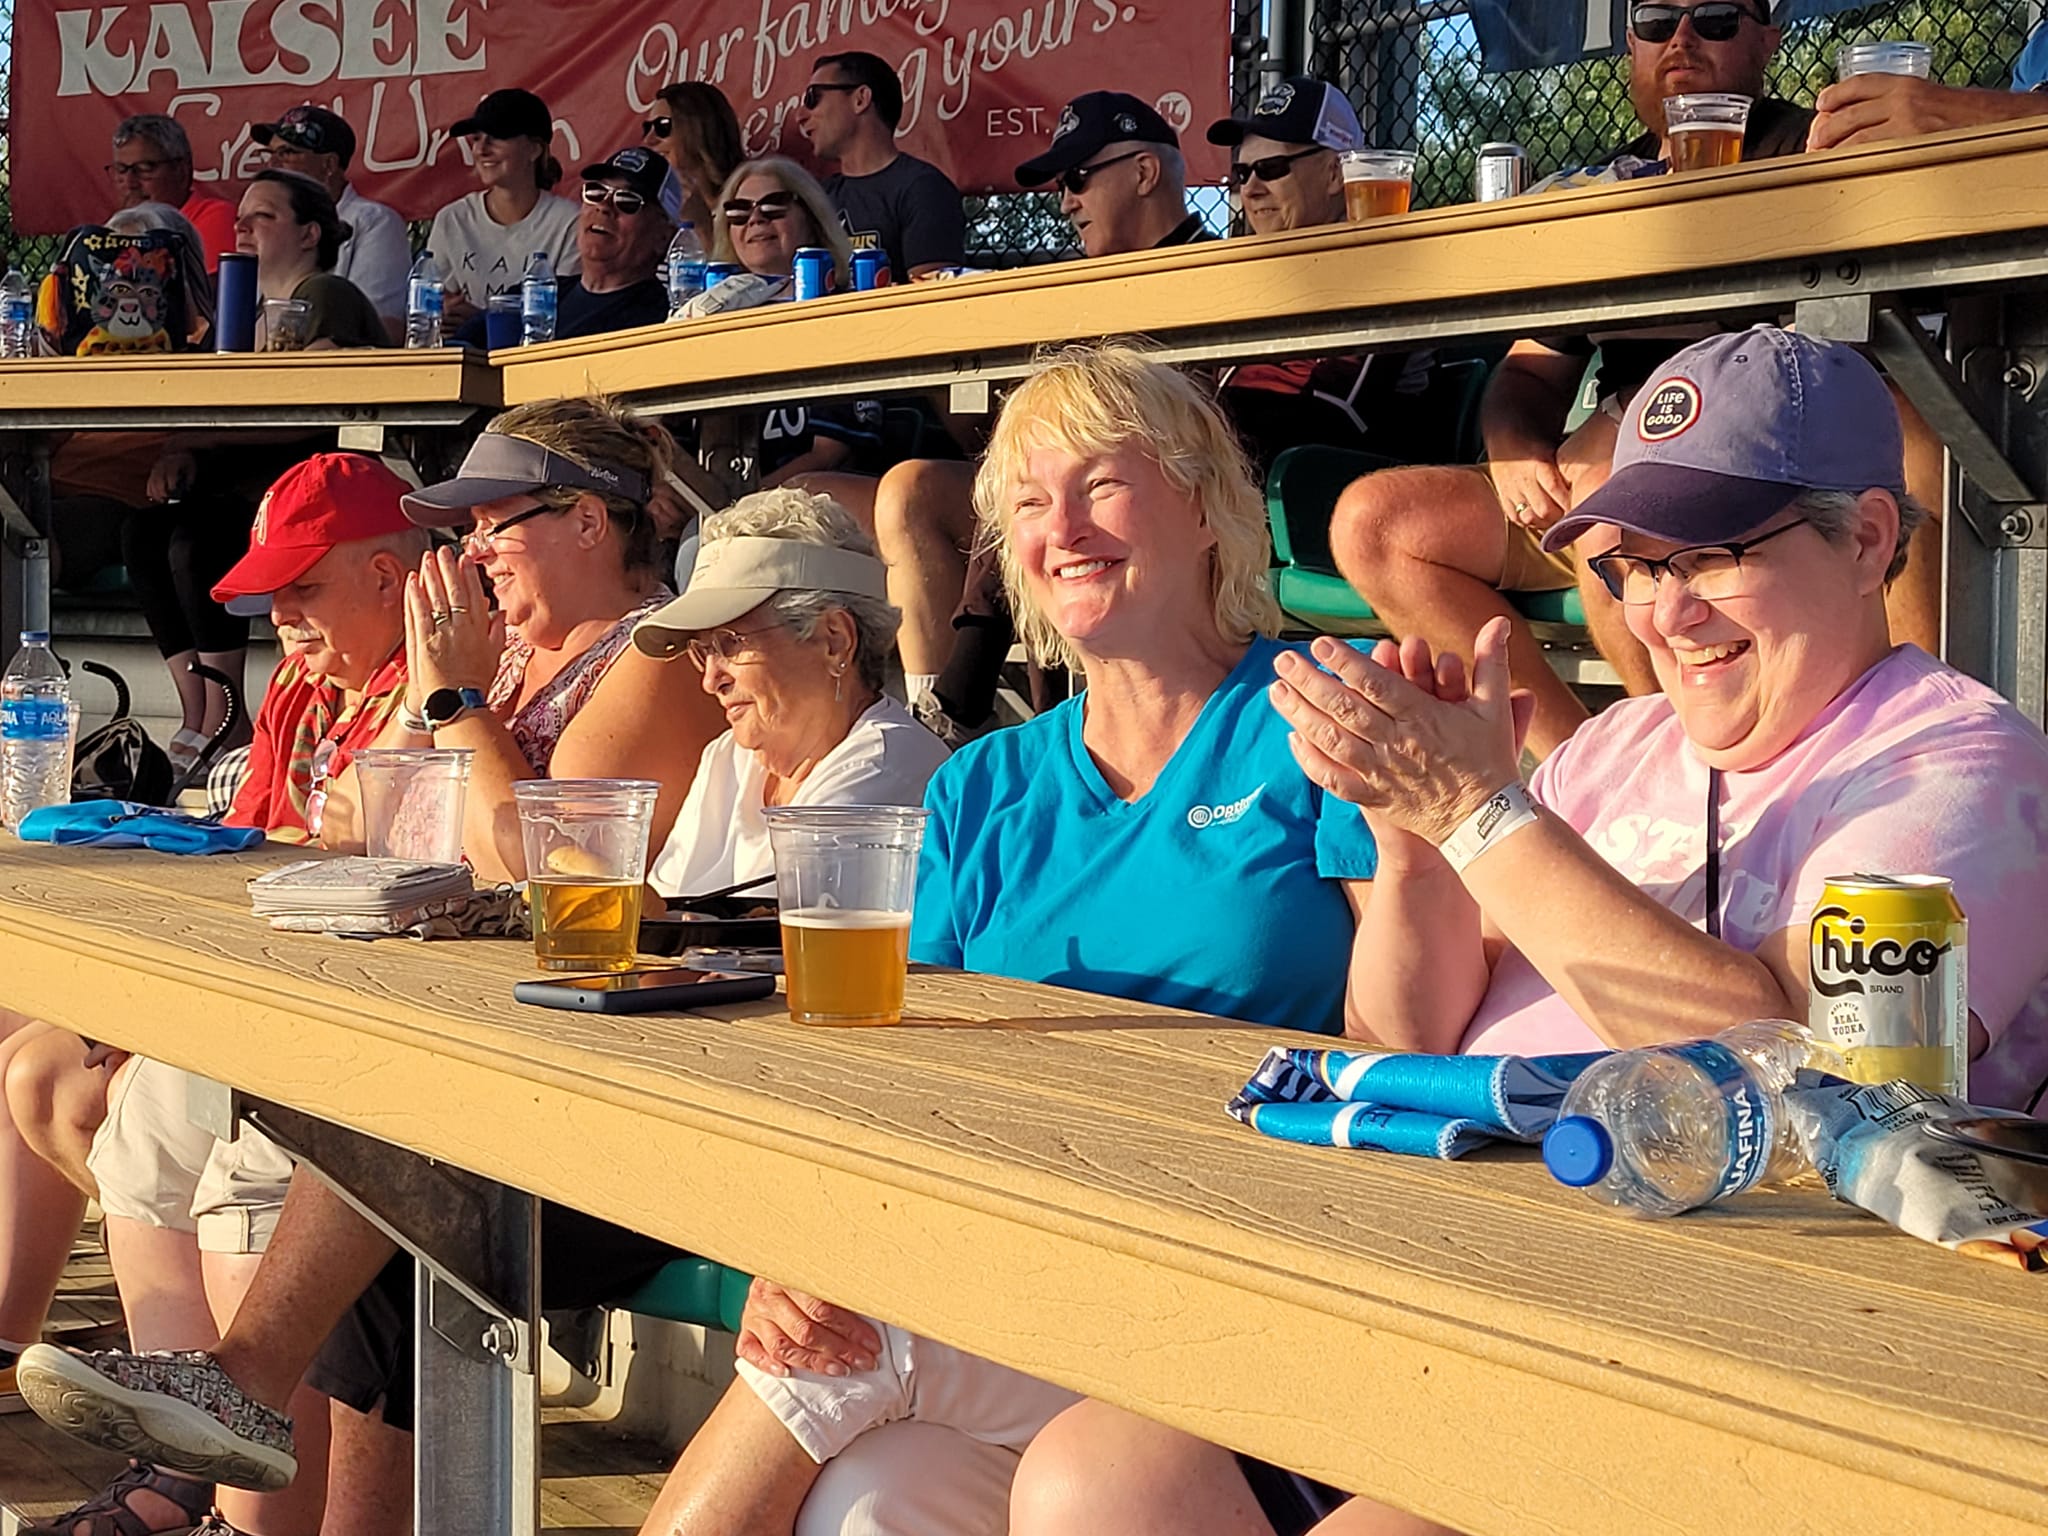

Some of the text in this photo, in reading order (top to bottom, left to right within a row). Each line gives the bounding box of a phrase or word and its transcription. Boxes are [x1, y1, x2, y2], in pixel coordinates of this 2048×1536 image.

[55, 0, 487, 96] KALSEE
[626, 22, 744, 113] Our
[937, 0, 1136, 120] yours.
[987, 107, 1050, 137] EST.
[1646, 414, 1683, 426] GOOD
[1660, 404, 1674, 415] IS
[1810, 906, 1952, 996] Chico
[1870, 984, 1904, 995] BRAND
[1832, 1023, 1866, 1036] VODKA
[1721, 1085, 1753, 1196] UAFINA
